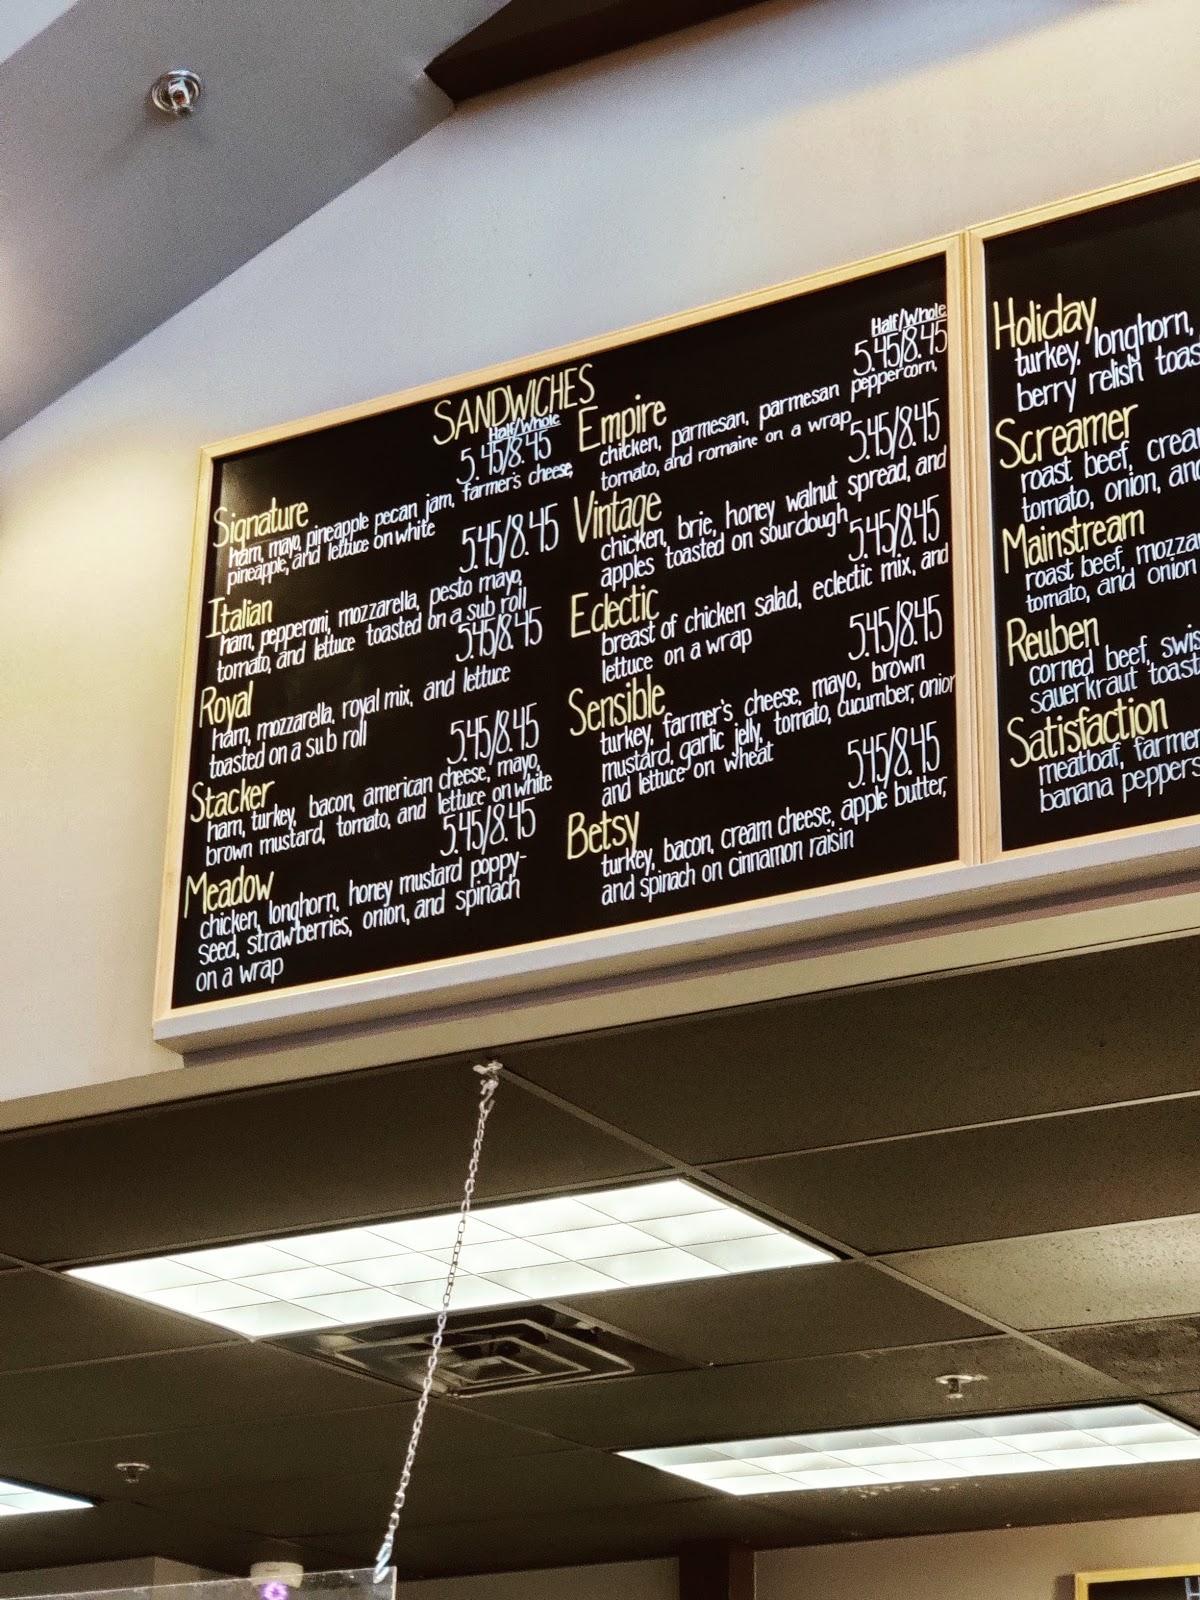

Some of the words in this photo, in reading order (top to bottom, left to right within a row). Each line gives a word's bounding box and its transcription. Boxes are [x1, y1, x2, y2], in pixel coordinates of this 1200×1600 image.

[853, 319, 948, 376] 5.45/8.45
[871, 303, 947, 335] Half/Whole
[993, 292, 1097, 350] Holiday
[1015, 340, 1081, 377] turkey,
[1094, 310, 1194, 362] longhorn,
[433, 363, 595, 445] SANDWICHES
[1017, 377, 1076, 413] berry
[1089, 353, 1144, 394] relish
[487, 413, 562, 443] Half/Whole
[578, 393, 667, 452] Empire
[600, 435, 662, 467] chicken,
[672, 411, 749, 457] parmesan,
[759, 383, 840, 431] parmesan
[601, 461, 660, 492] tomato,
[664, 446, 693, 472] and
[698, 435, 758, 462] romaine
[765, 429, 784, 443] on
[791, 424, 801, 437] a
[808, 410, 852, 432] wrap
[848, 398, 940, 463] 5.45/8.45
[995, 403, 1138, 469] Screamer
[456, 429, 552, 485] 5.45/8.45
[1021, 455, 1073, 494] roast
[1084, 440, 1133, 478] beef,
[213, 497, 309, 548] Signature
[229, 546, 264, 568] ham,
[268, 534, 301, 559] mayo,
[307, 512, 369, 551] pineapple
[374, 502, 418, 535] pecan
[423, 493, 455, 522] jam,
[528, 462, 573, 486] cheese,
[573, 490, 663, 543] Vintage
[600, 528, 667, 562] chicken,
[678, 510, 717, 540] brie,
[725, 500, 775, 528] honey
[786, 474, 838, 512] walnut
[848, 455, 911, 502] spread,
[915, 444, 947, 477] and
[1021, 484, 1095, 523] tomato,
[1105, 471, 1161, 502] onion,
[459, 503, 559, 573] 5.45/8.45
[600, 554, 655, 592] apples
[665, 532, 725, 569] toasted
[731, 531, 753, 552] on
[760, 502, 848, 545] sourdough
[848, 494, 940, 562] 5.45/8.45
[1002, 509, 1145, 574] Mainstream
[227, 557, 289, 595] pineapple,
[292, 545, 321, 570] and
[328, 538, 370, 562] lettuce
[1025, 558, 1075, 591] roast
[1081, 545, 1126, 578] beef,
[1025, 583, 1090, 614] tomato,
[1097, 567, 1136, 596] and
[1147, 557, 1197, 585] onion
[205, 597, 273, 638] Italian
[219, 633, 255, 657] ham,
[260, 609, 331, 654] pepperoni,
[338, 590, 420, 628] mozzarella,
[429, 576, 472, 617] pesto
[478, 569, 523, 596] mayo,
[570, 584, 660, 638] Eclectic
[601, 620, 656, 656] breast
[660, 613, 678, 639] of
[684, 601, 746, 634] chicken
[754, 580, 802, 617] salad,
[813, 564, 873, 600] eclectic
[880, 553, 917, 582] mix,
[921, 542, 949, 570] and
[848, 594, 943, 661] 5.45/8.45
[217, 654, 272, 683] tomato,
[276, 639, 306, 669] and
[314, 634, 356, 661] lettuce
[366, 612, 422, 647] toasted
[427, 611, 446, 630] on
[450, 608, 462, 625] a
[466, 594, 495, 622] sub
[501, 586, 527, 614] roll
[455, 606, 543, 663] 5.45/8.45
[602, 655, 654, 684] lettuce
[664, 646, 685, 666] on
[690, 642, 701, 660] a
[706, 627, 752, 653] wrap
[1006, 613, 1100, 667] Reuben
[1029, 649, 1094, 687] corned
[1106, 635, 1150, 672] beef,
[199, 680, 253, 731] Royal
[212, 727, 251, 751] ham,
[256, 702, 335, 741] mozzarella,
[342, 687, 380, 727] royal
[384, 684, 414, 710] mix,
[423, 670, 456, 701] and
[463, 664, 512, 693] lettuce
[568, 673, 665, 736] Sensible
[600, 724, 654, 756] turkey,
[744, 687, 802, 717] cheese,
[812, 670, 862, 701] mayo,
[872, 653, 925, 683] brown
[1030, 667, 1138, 714] sauerkraut
[446, 702, 540, 765] 5.45/8.45
[602, 741, 674, 783] mustard,
[679, 728, 725, 769] garlic
[732, 717, 763, 757] jelly,
[773, 701, 832, 735] tomato,
[837, 684, 915, 718] cucumber,
[847, 720, 941, 790] 5.45/8.45
[1007, 697, 1169, 768] Satisfaction
[601, 776, 631, 807] and
[639, 767, 685, 795] lettuce
[1039, 742, 1125, 786] meatloaf,
[1040, 776, 1114, 813] banana
[190, 778, 275, 823] Stacker
[206, 843, 253, 867] brown
[259, 819, 326, 856] mustard,
[336, 808, 391, 838] tomato,
[397, 796, 427, 825] and
[437, 789, 486, 815] lettuce
[207, 818, 246, 843] ham,
[251, 803, 297, 831] turkey,
[309, 794, 356, 819] bacon,
[363, 776, 433, 807] american
[438, 766, 491, 790] cheese,
[497, 753, 541, 780] mayo,
[440, 797, 536, 857] 5.45/8.45
[601, 847, 656, 878] turkey,
[663, 834, 714, 863] bacon,
[721, 819, 773, 849] cream
[778, 806, 835, 836] cheese,
[840, 785, 888, 825] apple
[894, 775, 948, 808] butter,
[567, 809, 640, 860] Betsy
[184, 865, 275, 919] Meadow
[200, 909, 261, 940] chicken,
[268, 891, 340, 927] longhorn,
[349, 879, 393, 907] honey
[400, 856, 463, 895] mustard
[471, 851, 527, 888] poppy-
[601, 873, 635, 906] and
[640, 862, 696, 903] spinach
[702, 862, 723, 883] on
[728, 840, 803, 878] cinnamon
[809, 827, 854, 858] raisin
[198, 934, 240, 966] seed,
[247, 914, 353, 955] strawberries,
[363, 904, 410, 930] onion,
[414, 888, 445, 919] and
[455, 874, 521, 916] spinach
